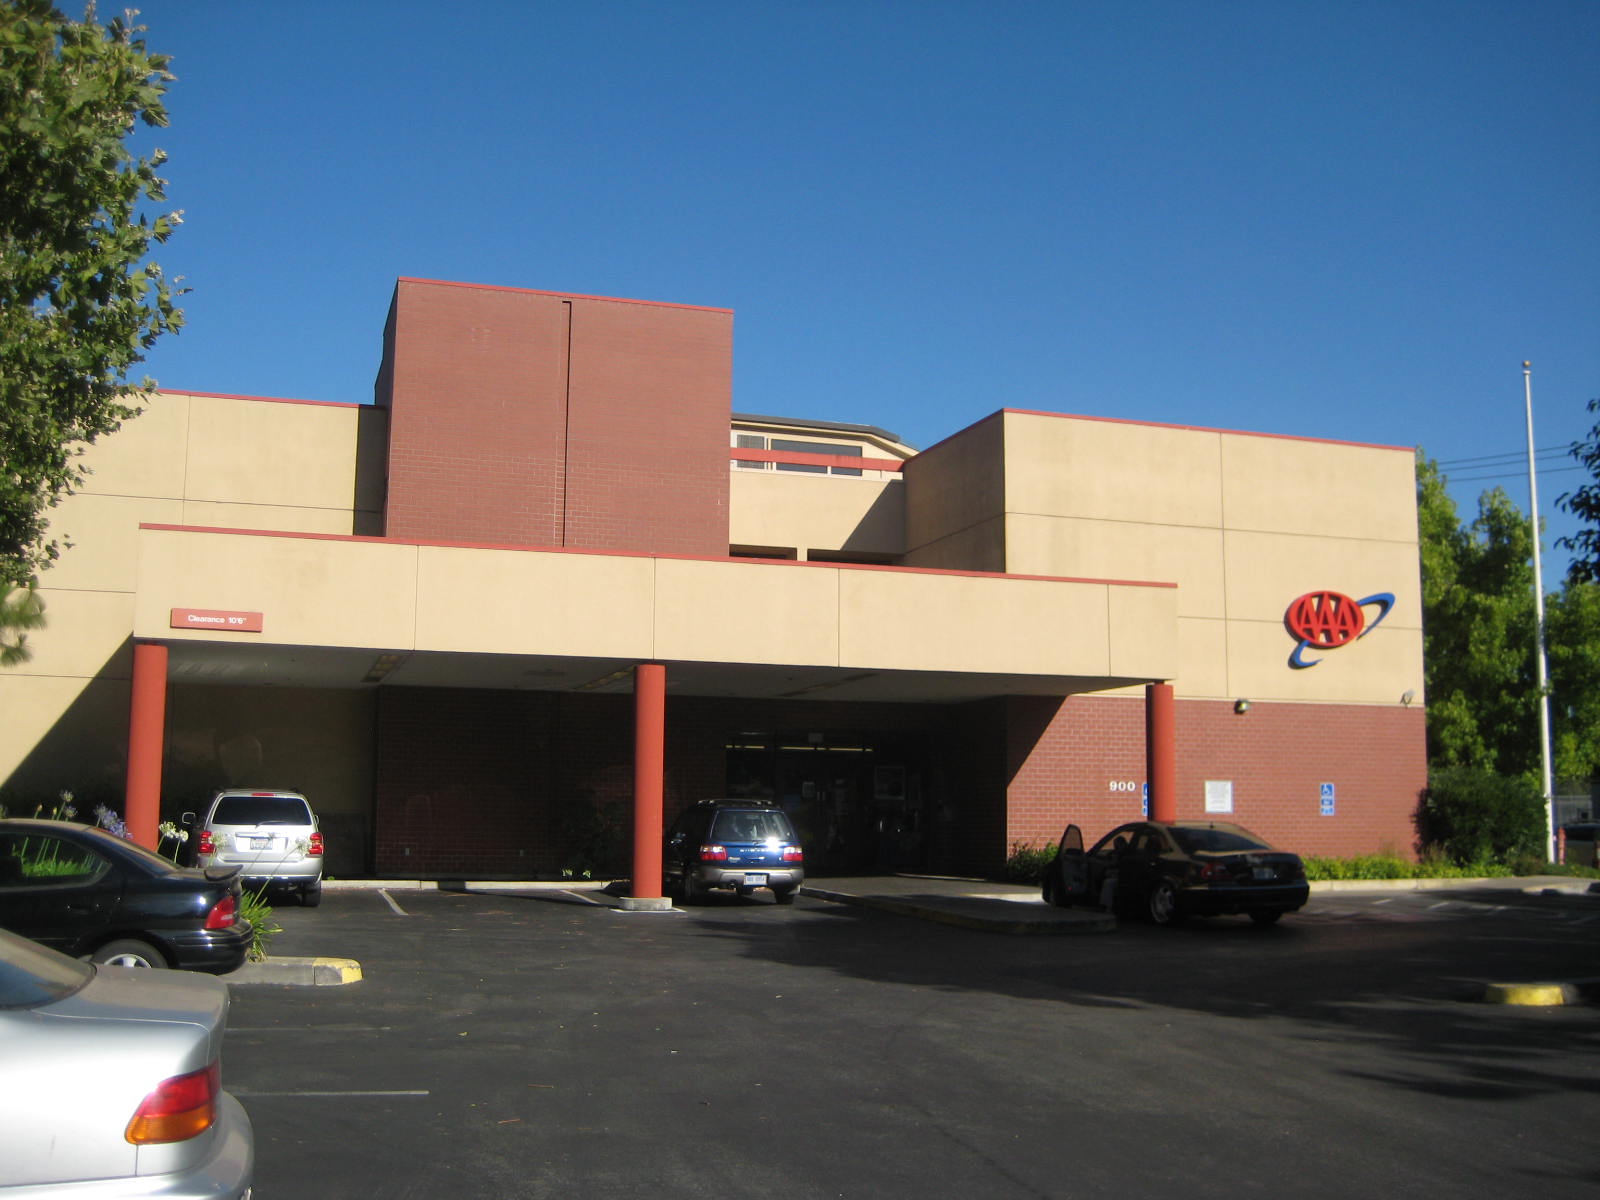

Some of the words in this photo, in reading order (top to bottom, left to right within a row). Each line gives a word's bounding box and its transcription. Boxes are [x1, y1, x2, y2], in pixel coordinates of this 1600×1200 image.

[188, 614, 226, 624] Clearance
[1292, 591, 1361, 645] AAA
[1109, 780, 1136, 792] 900
